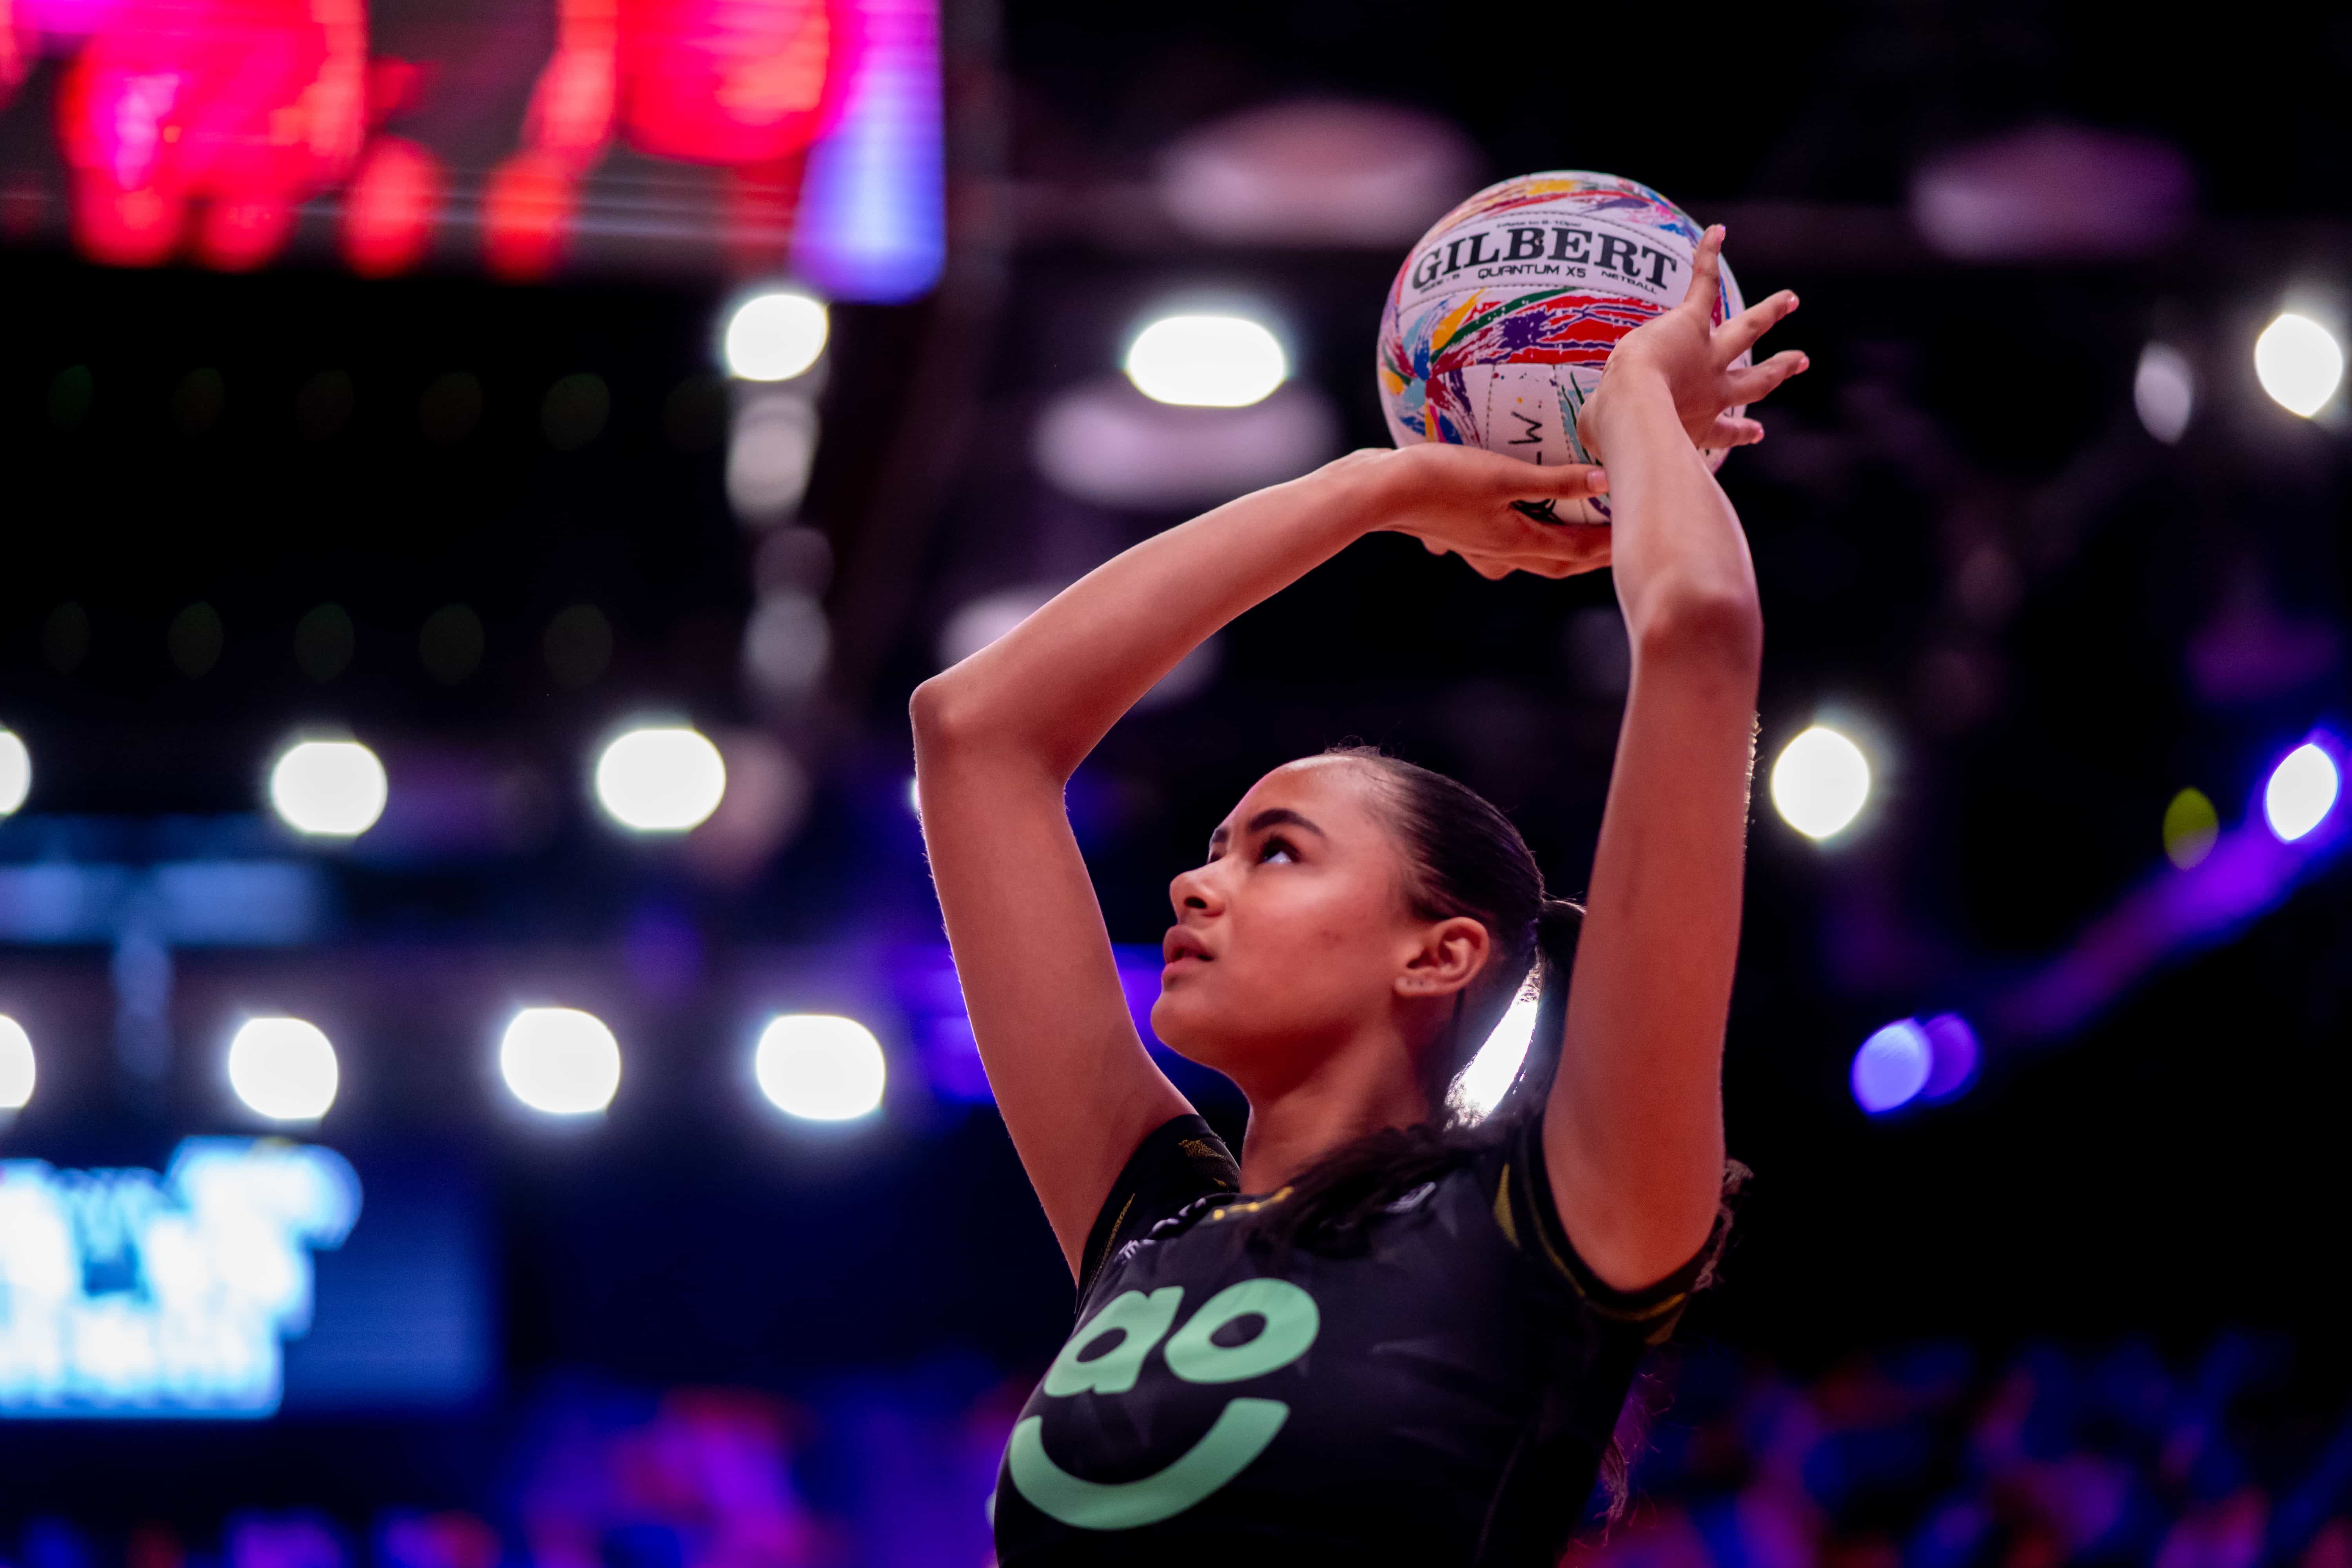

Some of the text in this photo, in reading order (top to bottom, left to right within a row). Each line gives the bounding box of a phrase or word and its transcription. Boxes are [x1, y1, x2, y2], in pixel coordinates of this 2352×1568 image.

[1412, 227, 1677, 290] GILBERT
[1477, 264, 1586, 280] QUANTUM X5
[1601, 270, 1657, 294] NETBALL
[1044, 1277, 1320, 1397] ao
